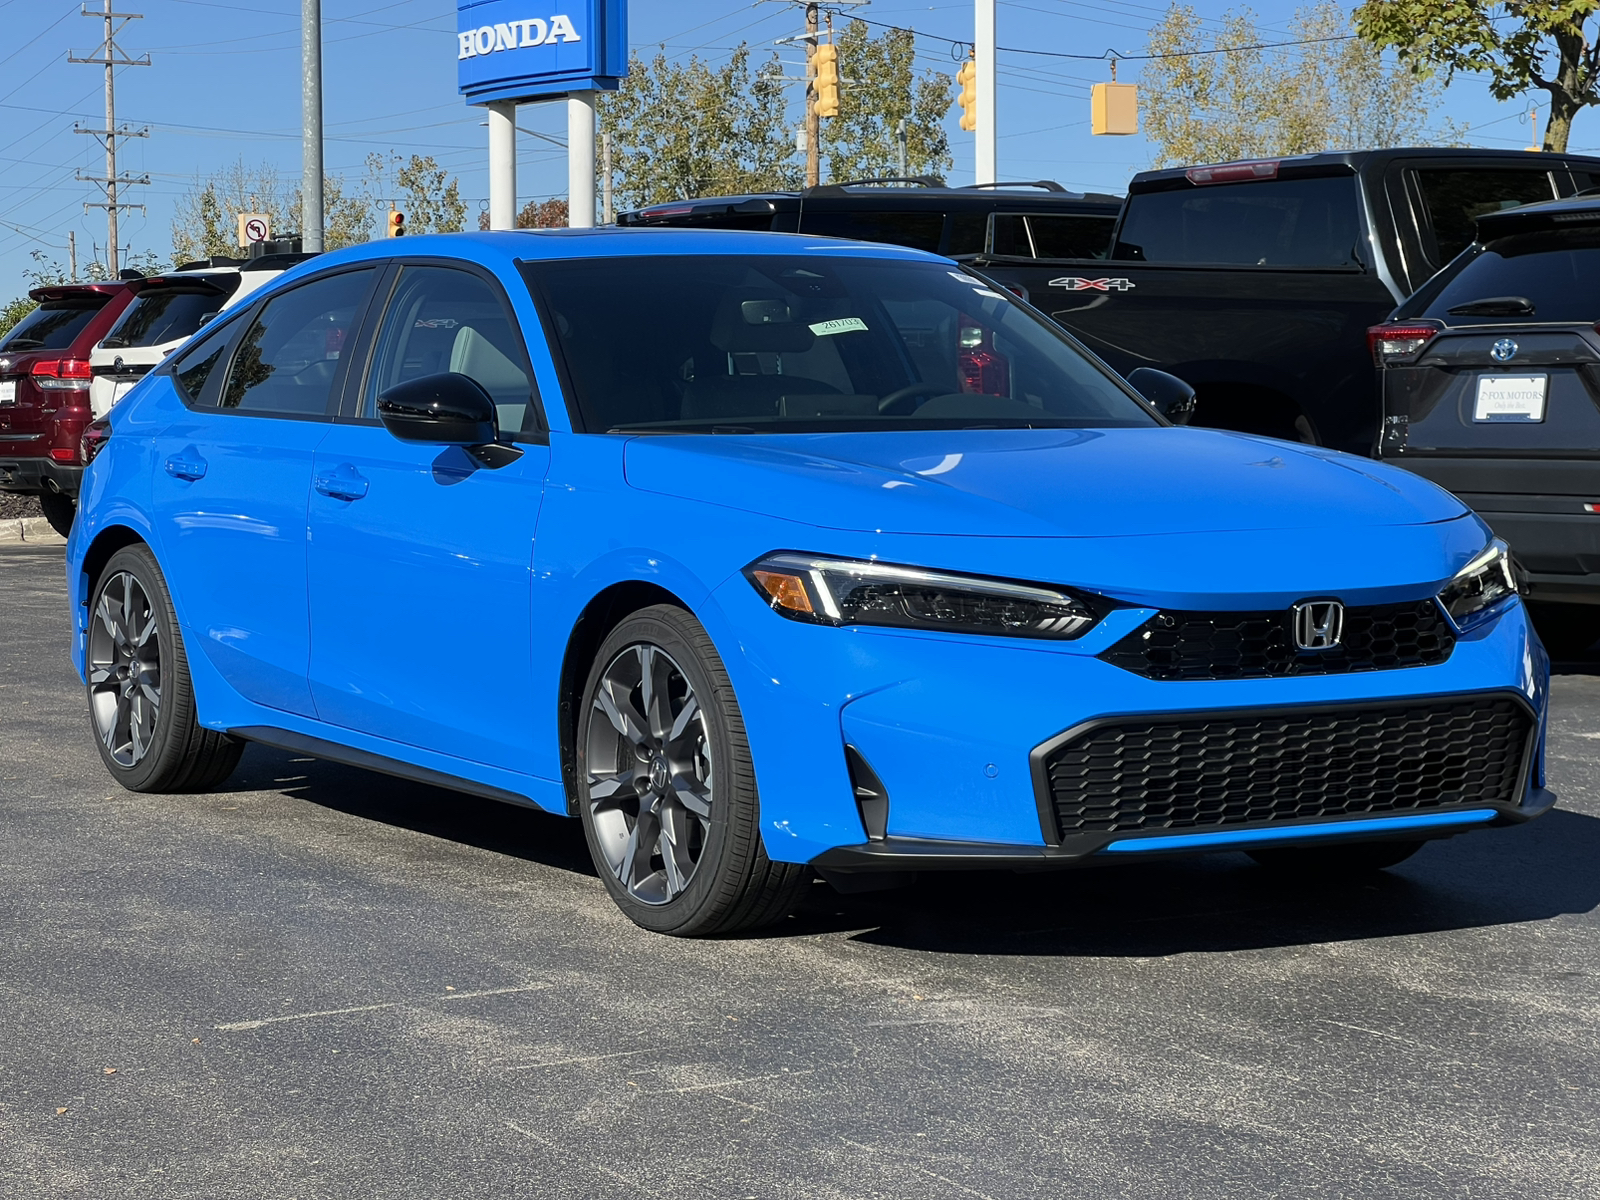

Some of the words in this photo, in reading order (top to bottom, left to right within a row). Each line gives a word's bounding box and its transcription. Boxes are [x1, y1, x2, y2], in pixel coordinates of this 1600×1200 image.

[458, 15, 581, 60] HONDA
[1488, 391, 1505, 400] FOX
[1506, 391, 1543, 400] MOTORS
